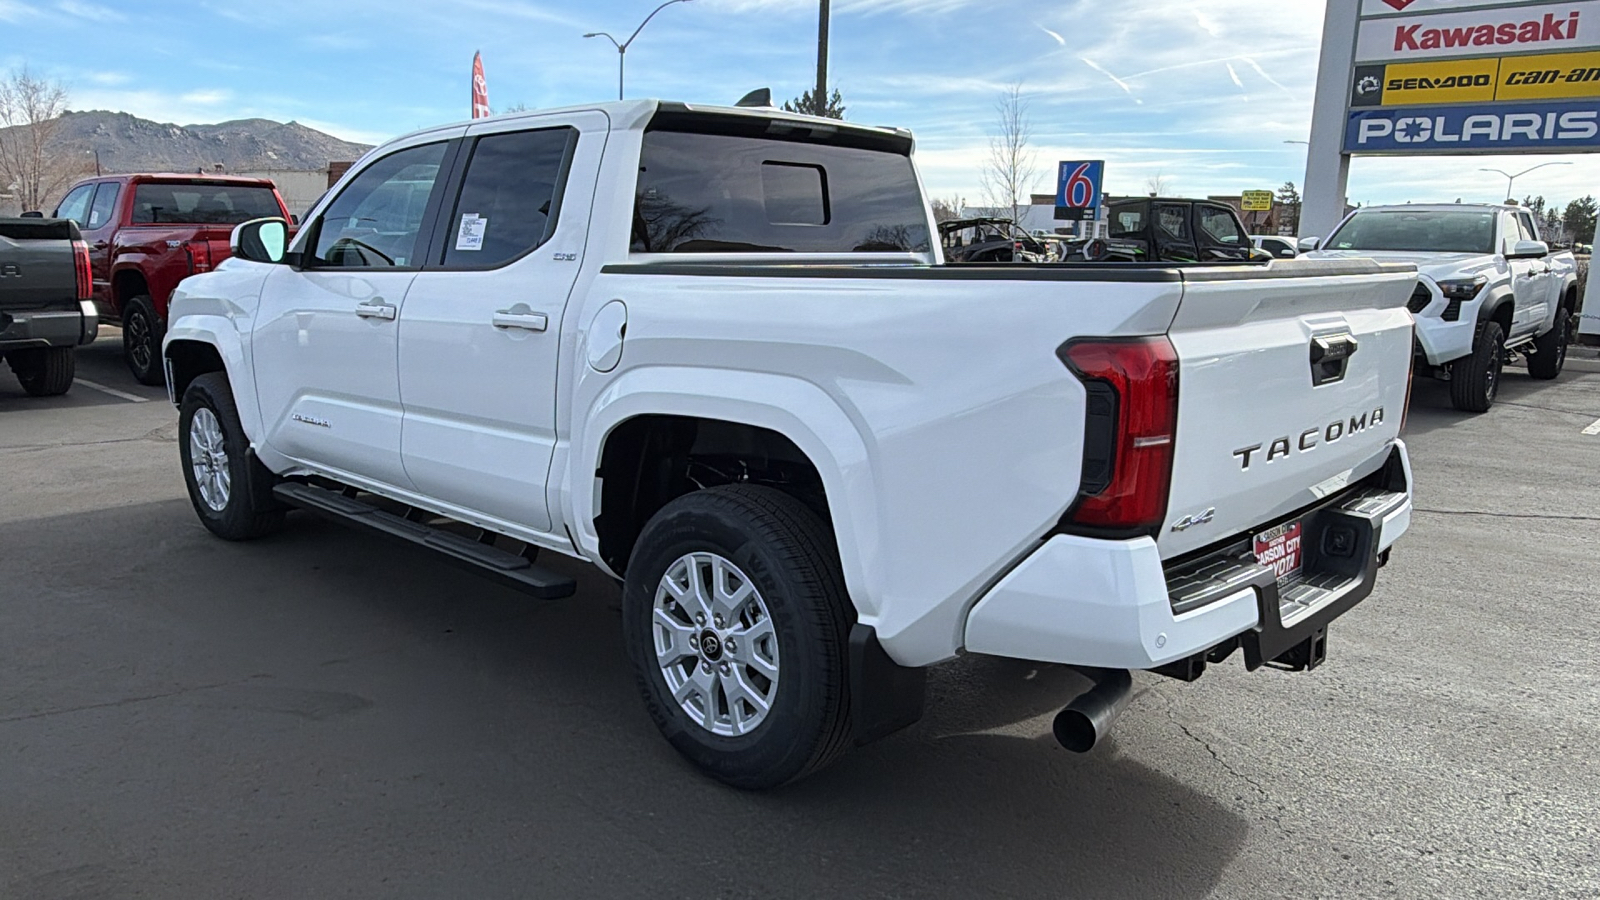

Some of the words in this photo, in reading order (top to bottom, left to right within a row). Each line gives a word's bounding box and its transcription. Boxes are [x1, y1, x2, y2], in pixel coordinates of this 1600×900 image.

[1393, 11, 1580, 51] Kawasaki
[1357, 111, 1598, 144] POLARIS
[1064, 162, 1094, 208] 6
[1233, 406, 1384, 471] TACOMA
[1270, 552, 1296, 578] YOTA
